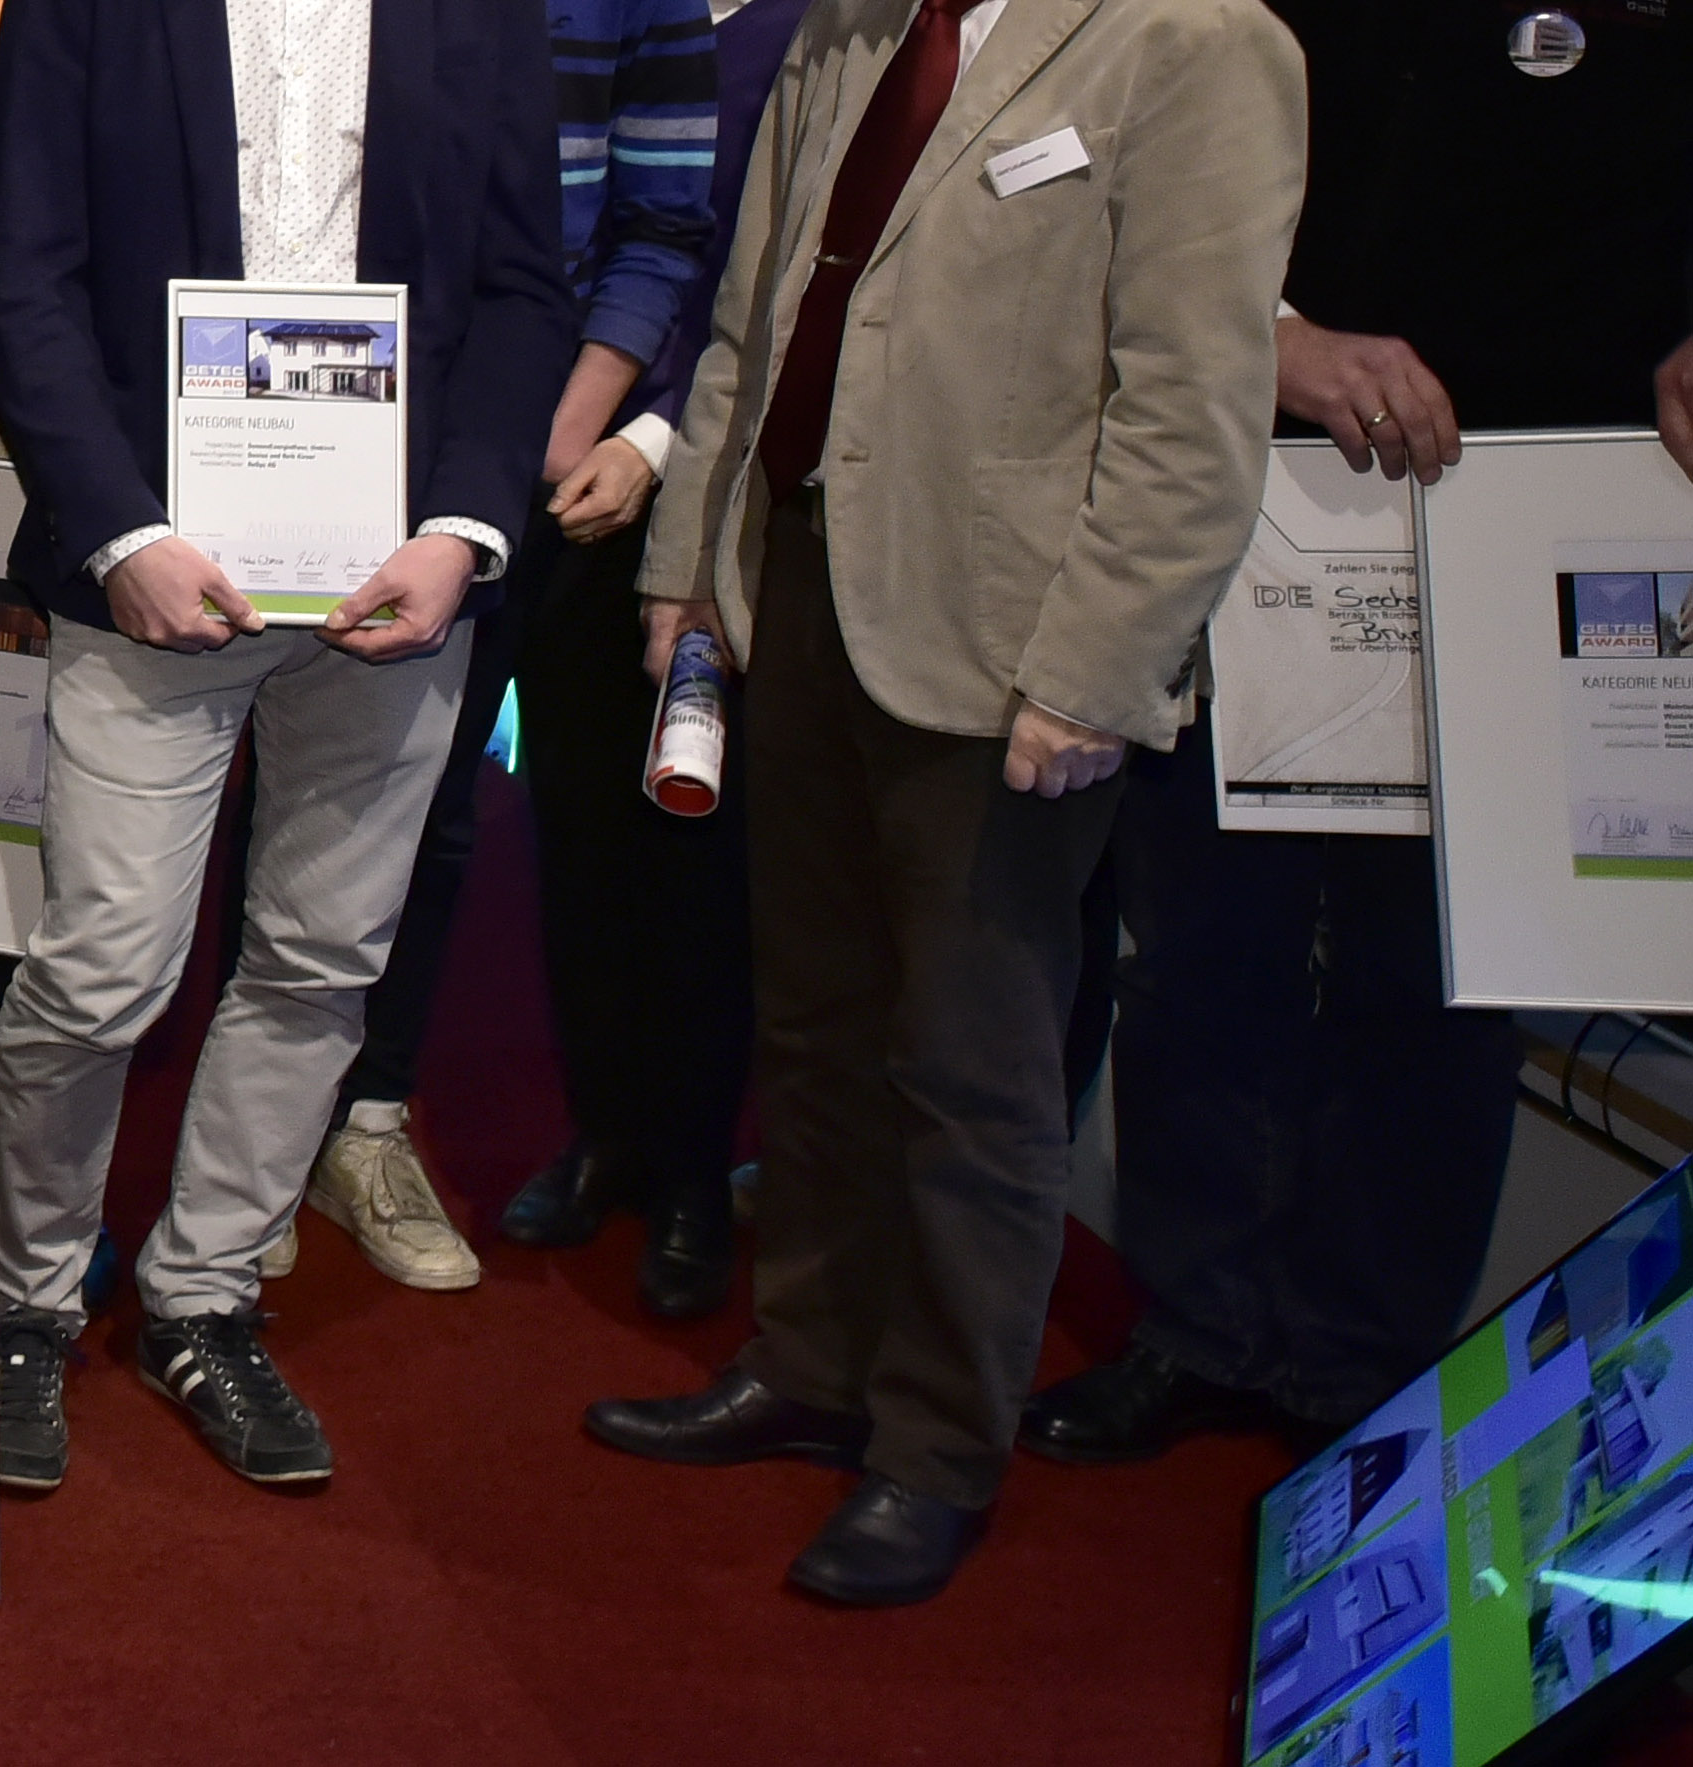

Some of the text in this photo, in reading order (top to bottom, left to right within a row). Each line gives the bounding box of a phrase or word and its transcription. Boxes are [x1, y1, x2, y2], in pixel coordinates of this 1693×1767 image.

[185, 378, 246, 389] AWARD
[184, 415, 295, 430] KATEGORIE NEUBAU
[1325, 563, 1366, 574] Zahlen
[1370, 563, 1387, 574] Sie
[1254, 584, 1314, 609] DE
[1581, 637, 1656, 647] AWARD
[1581, 676, 1693, 690] KATEGORIE NEU
